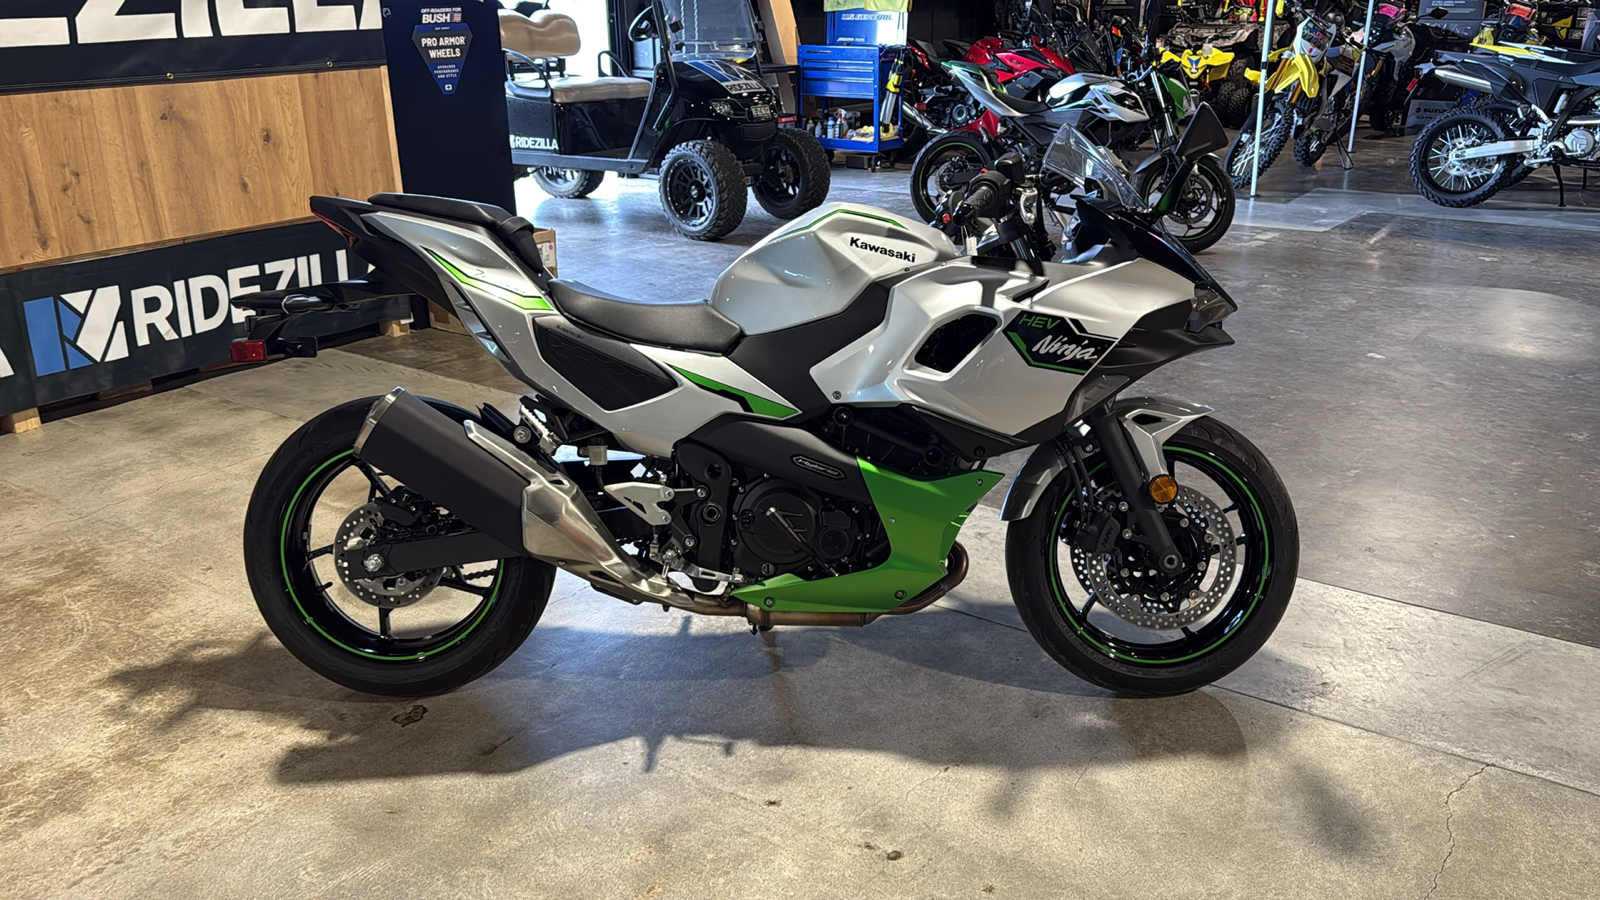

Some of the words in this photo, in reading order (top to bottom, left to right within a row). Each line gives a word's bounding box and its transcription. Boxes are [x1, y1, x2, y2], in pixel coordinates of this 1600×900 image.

[422, 13, 450, 23] BUSH
[421, 38, 437, 47] PRO
[439, 36, 466, 46] ARMOR
[428, 48, 461, 58] WHEELS
[515, 136, 559, 150] RIDEZILLA
[849, 236, 916, 263] Kawasaki
[130, 248, 377, 347] RIDEZI
[1018, 314, 1060, 330] HEV
[1031, 334, 1098, 363] Ninja
